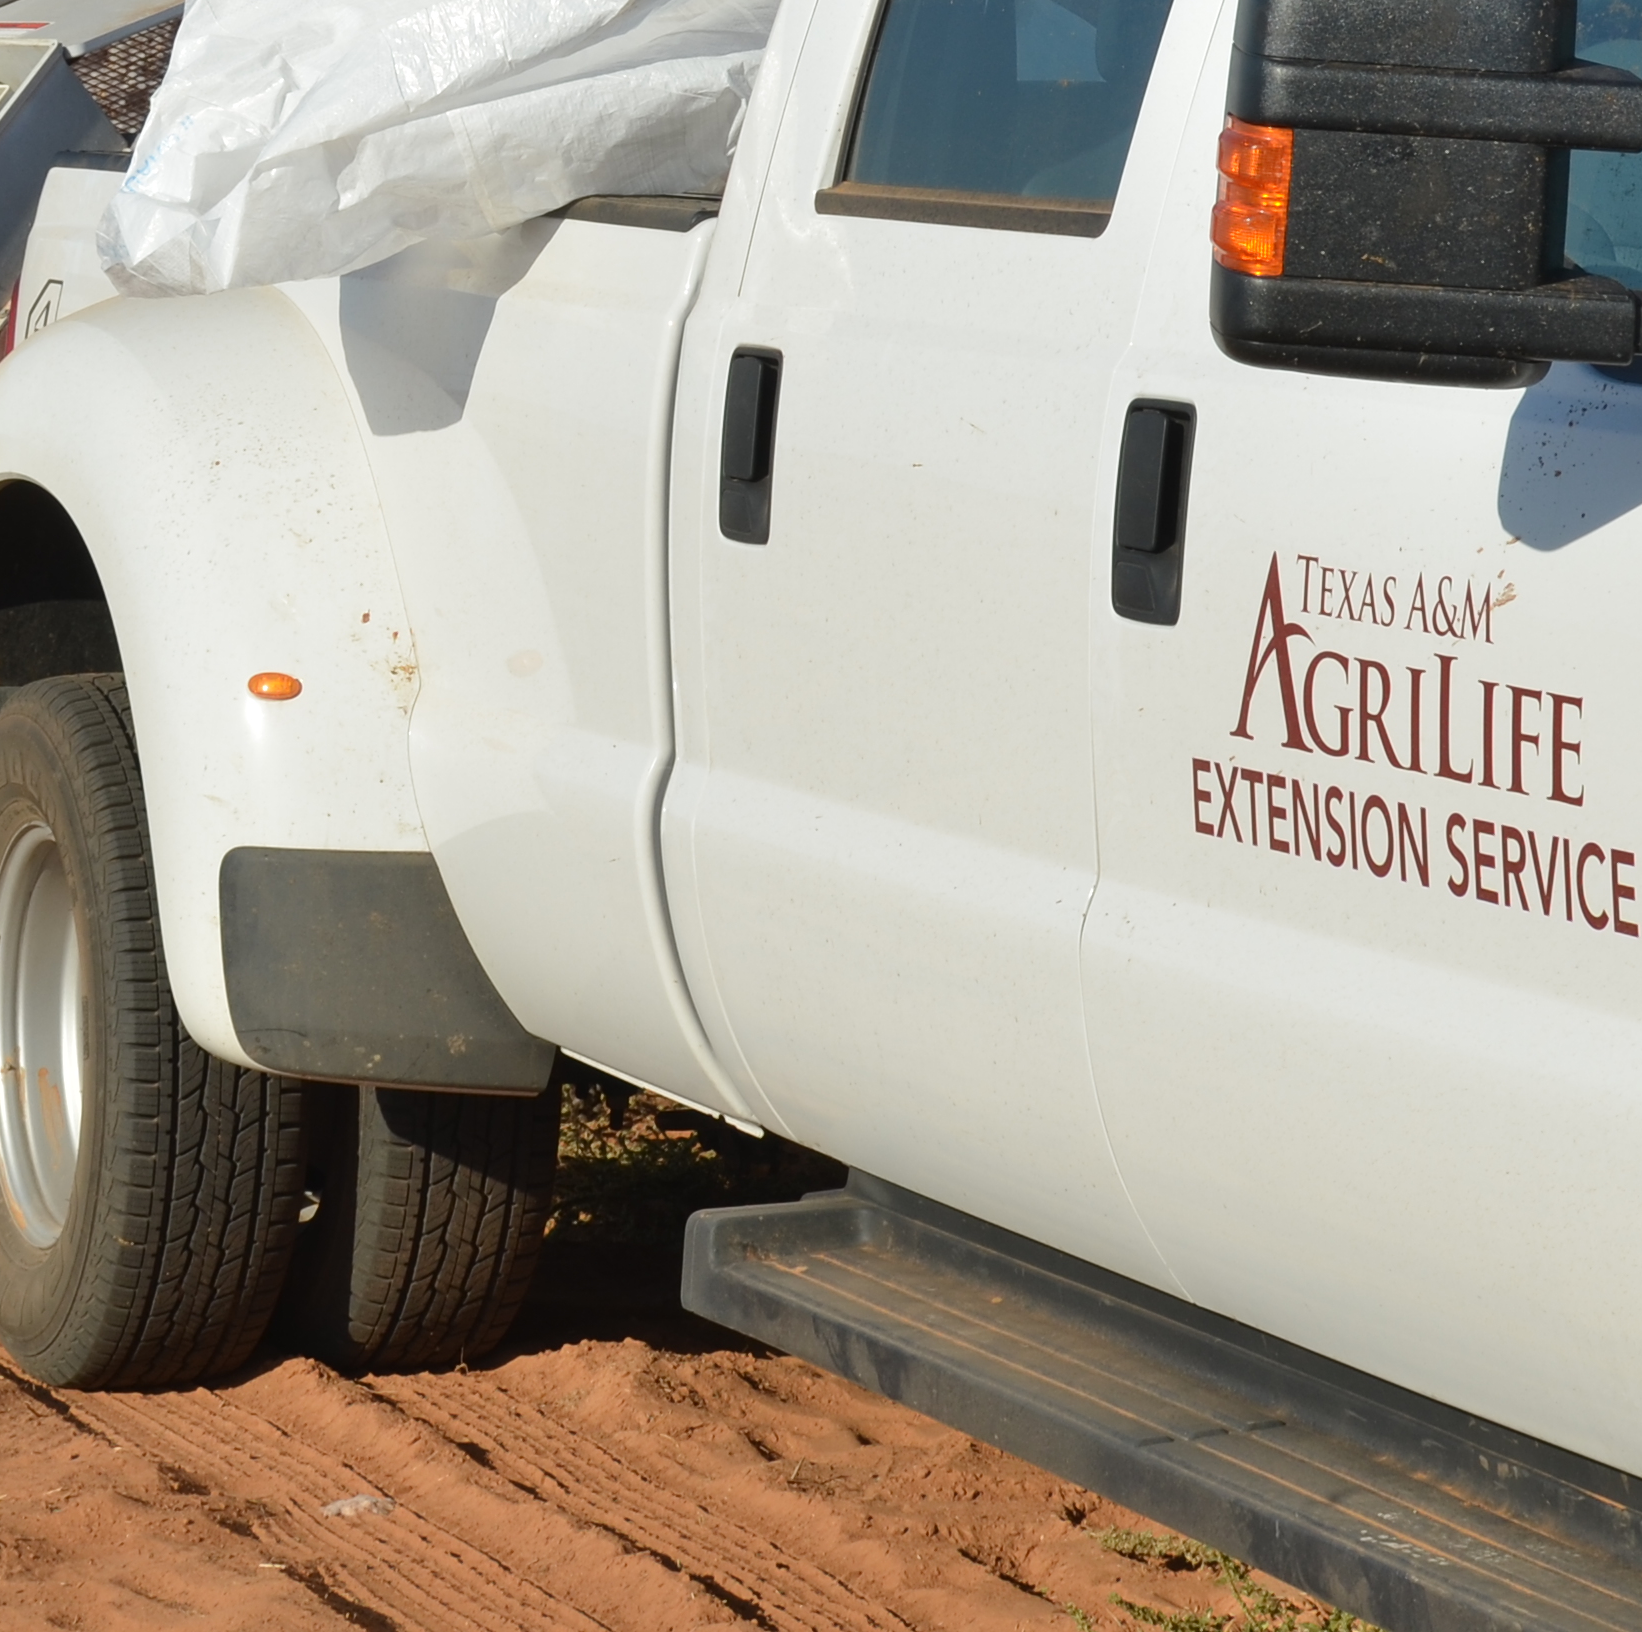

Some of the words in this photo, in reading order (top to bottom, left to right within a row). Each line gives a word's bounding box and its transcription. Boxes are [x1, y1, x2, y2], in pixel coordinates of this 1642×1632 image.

[1296, 554, 1397, 629] TEXAS
[1405, 570, 1495, 646] A&M
[1191, 757, 1431, 889] EXTENSION
[1445, 811, 1640, 938] SERVICE
